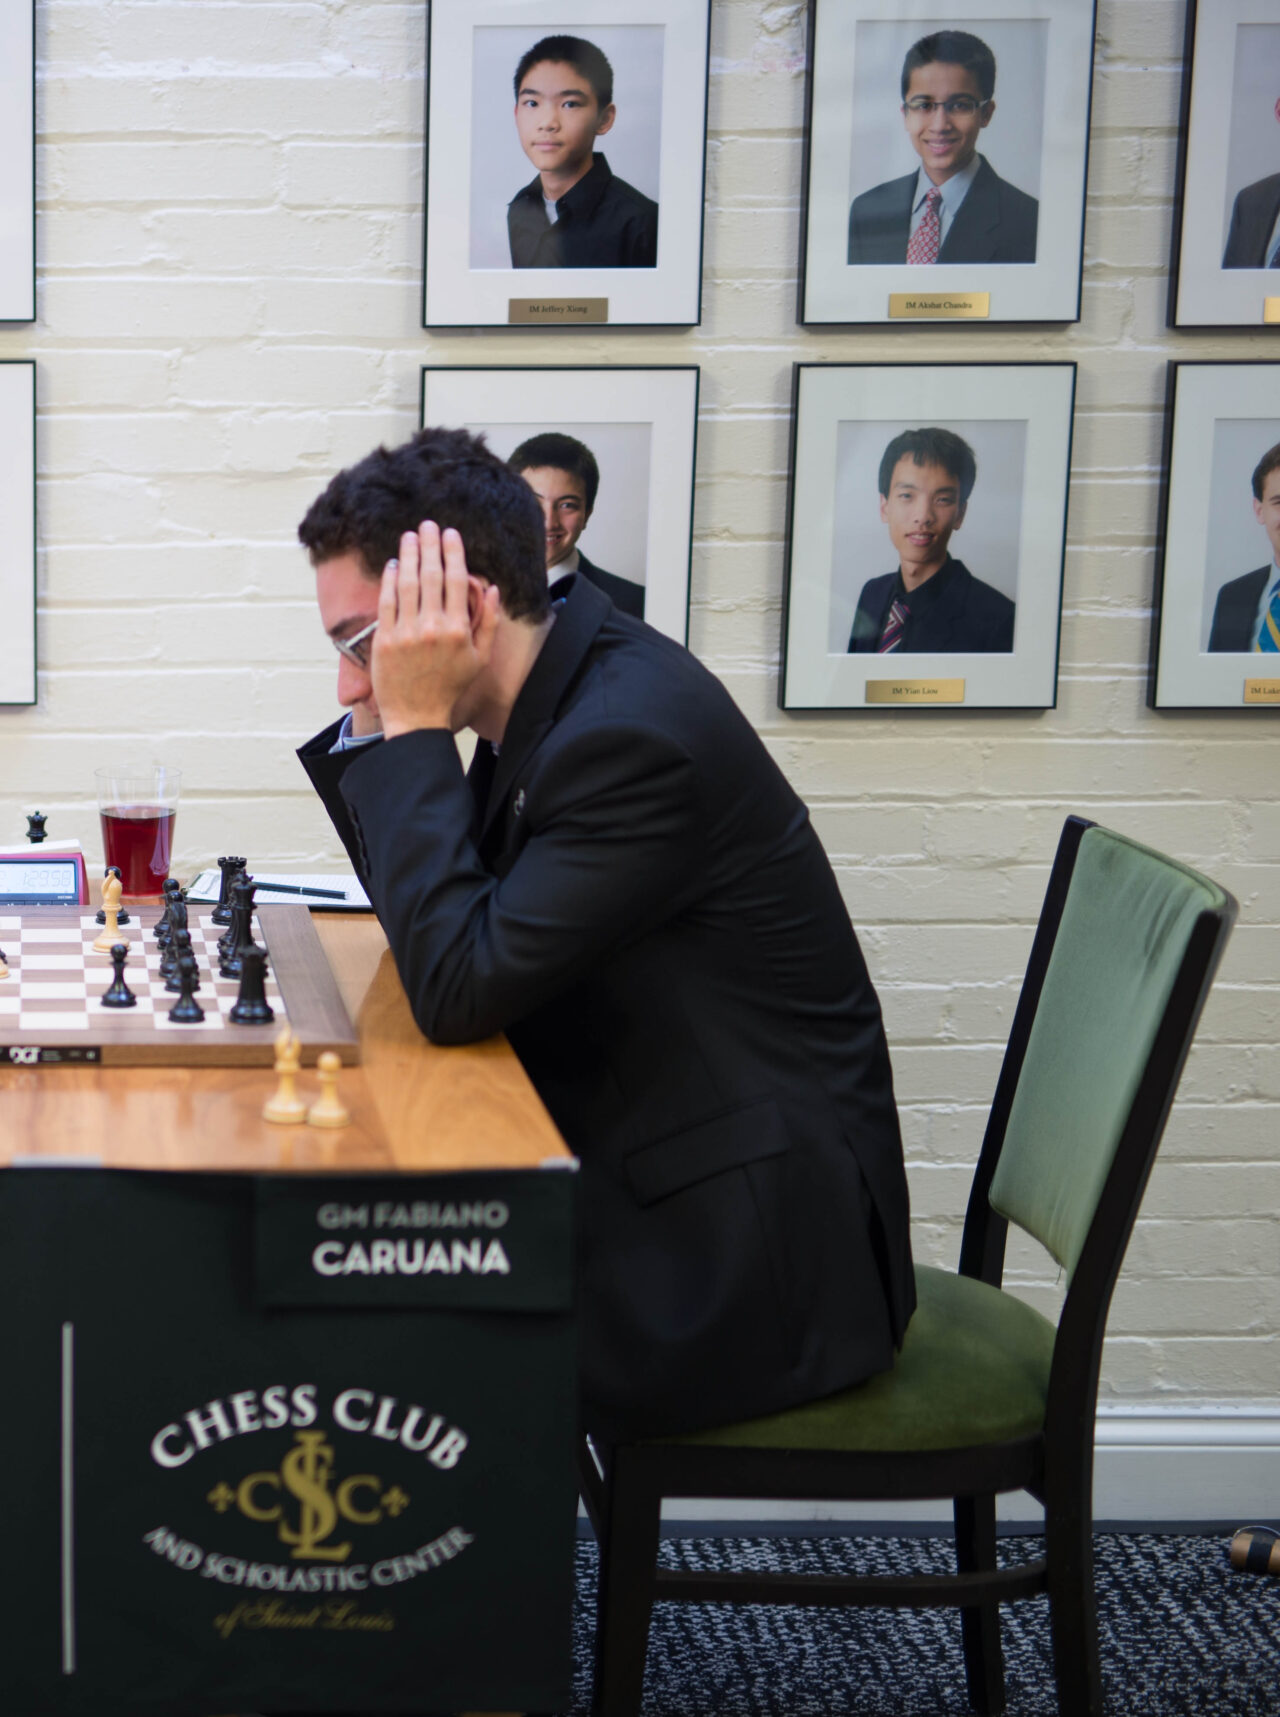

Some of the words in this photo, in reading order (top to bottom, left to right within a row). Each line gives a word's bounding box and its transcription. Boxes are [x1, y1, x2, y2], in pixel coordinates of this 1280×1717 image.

[529, 305, 540, 313] IM
[541, 304, 566, 314] Jeffery
[566, 305, 588, 314] Xiong
[905, 301, 917, 309] IM
[918, 301, 940, 309] Akshat
[943, 301, 972, 309] Chandra
[892, 687, 902, 695] IM
[1250, 687, 1261, 695] IM
[317, 1203, 369, 1230] GM
[374, 1201, 509, 1228] FABIANO
[313, 1239, 511, 1276] CARUANA
[150, 1384, 318, 1469] CHESS
[332, 1388, 470, 1471] CLUB
[143, 1525, 201, 1572] AND
[203, 1552, 370, 1593] SCHOLASTIC
[370, 1526, 475, 1587] CENTER
[242, 1597, 320, 1629] Saint
[321, 1597, 395, 1631] Louis
